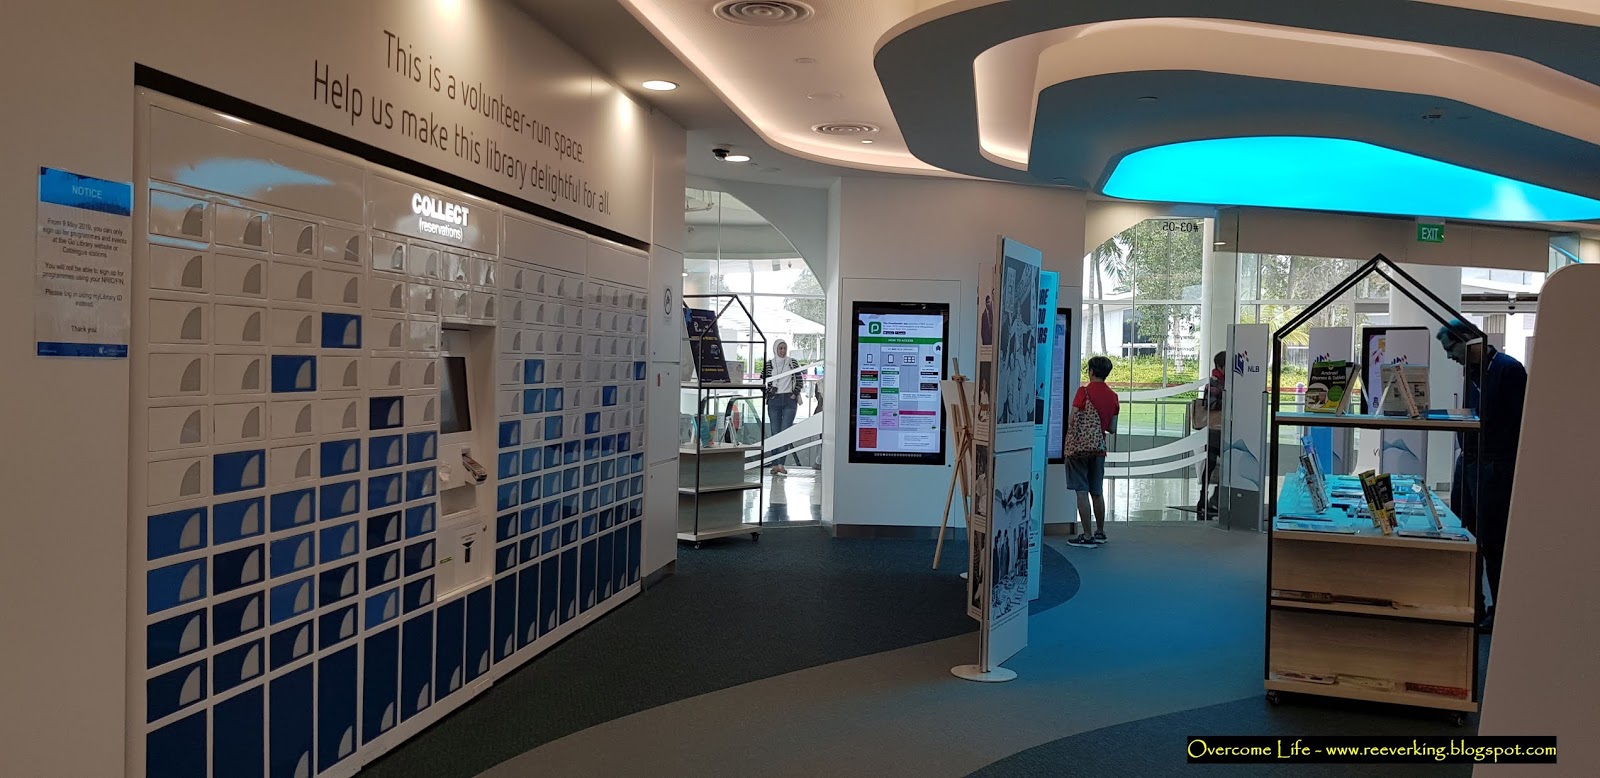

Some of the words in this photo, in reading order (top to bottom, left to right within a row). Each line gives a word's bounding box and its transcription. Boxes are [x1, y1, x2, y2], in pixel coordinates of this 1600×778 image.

[383, 29, 421, 83] This
[428, 55, 441, 92] is
[447, 75, 456, 100] a
[462, 80, 550, 148] volunteer-run
[554, 131, 585, 164] space.
[314, 59, 363, 126] Help
[372, 96, 394, 130] us
[402, 110, 448, 151] make
[454, 123, 480, 164] this
[486, 138, 527, 190] library
[530, 160, 580, 202] delightful
[582, 182, 597, 210] for
[598, 190, 611, 216] all.
[72, 184, 103, 199] NOTICE
[412, 192, 470, 227] COLLECT
[113, 228, 123, 236] only
[418, 217, 464, 242] (reservations)
[1421, 227, 1439, 240] EXIT
[1247, 365, 1260, 373] NLB
